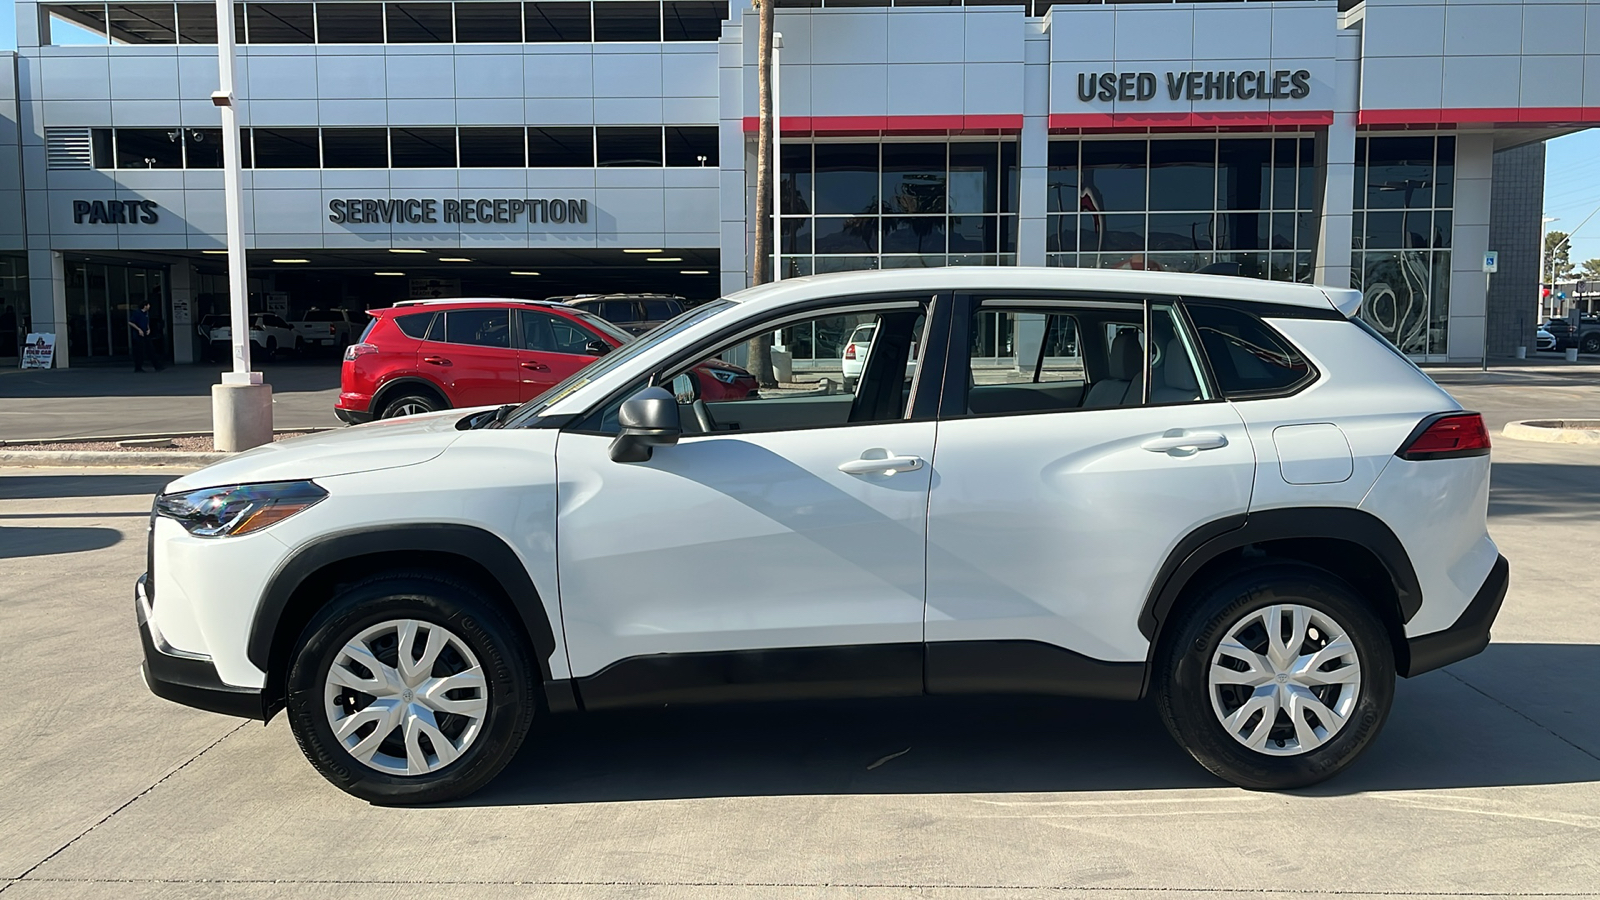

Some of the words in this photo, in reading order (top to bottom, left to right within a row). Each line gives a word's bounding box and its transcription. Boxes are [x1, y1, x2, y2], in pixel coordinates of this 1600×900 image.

[1077, 72, 1157, 102] USED
[1166, 70, 1311, 100] VEHICLES
[73, 199, 159, 224] PARTS
[329, 199, 437, 224] SERVICE
[443, 199, 588, 224] RECEPTION
